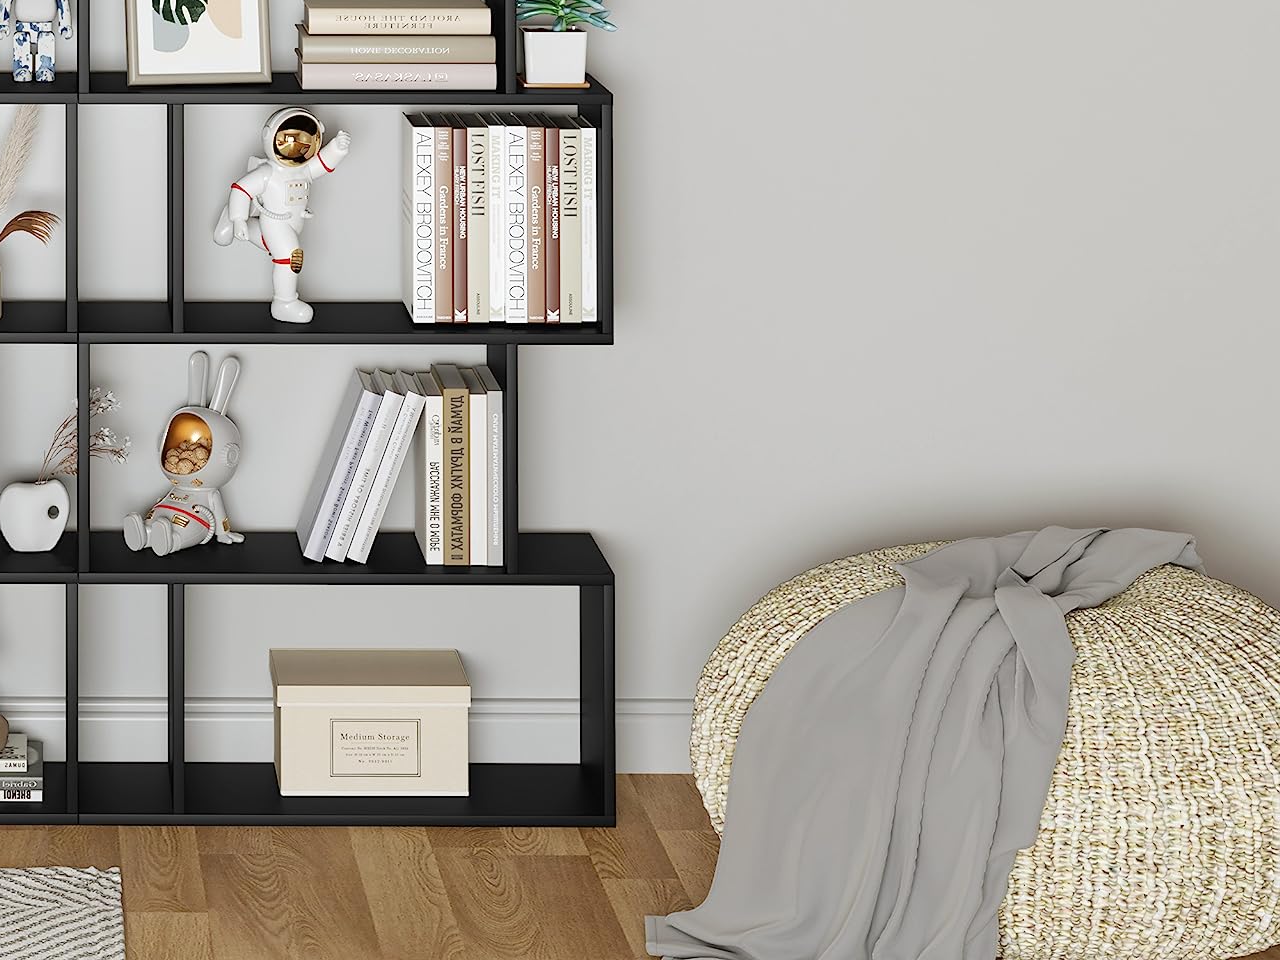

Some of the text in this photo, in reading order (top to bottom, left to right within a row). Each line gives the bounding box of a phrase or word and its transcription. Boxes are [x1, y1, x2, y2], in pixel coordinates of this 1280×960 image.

[417, 132, 432, 197] ALEXEY
[472, 133, 485, 216] LOST FISH
[491, 135, 500, 183] MAKING
[509, 132, 524, 197] ALEXEY
[564, 135, 577, 218] LOST FISH
[584, 137, 593, 185] MAKING
[416, 203, 432, 310] BRODOVITCH
[439, 186, 448, 269] Gardens in France
[509, 203, 524, 310] BRODOVITCH
[531, 186, 541, 269] Gardens in France
[378, 733, 410, 742] Storage
